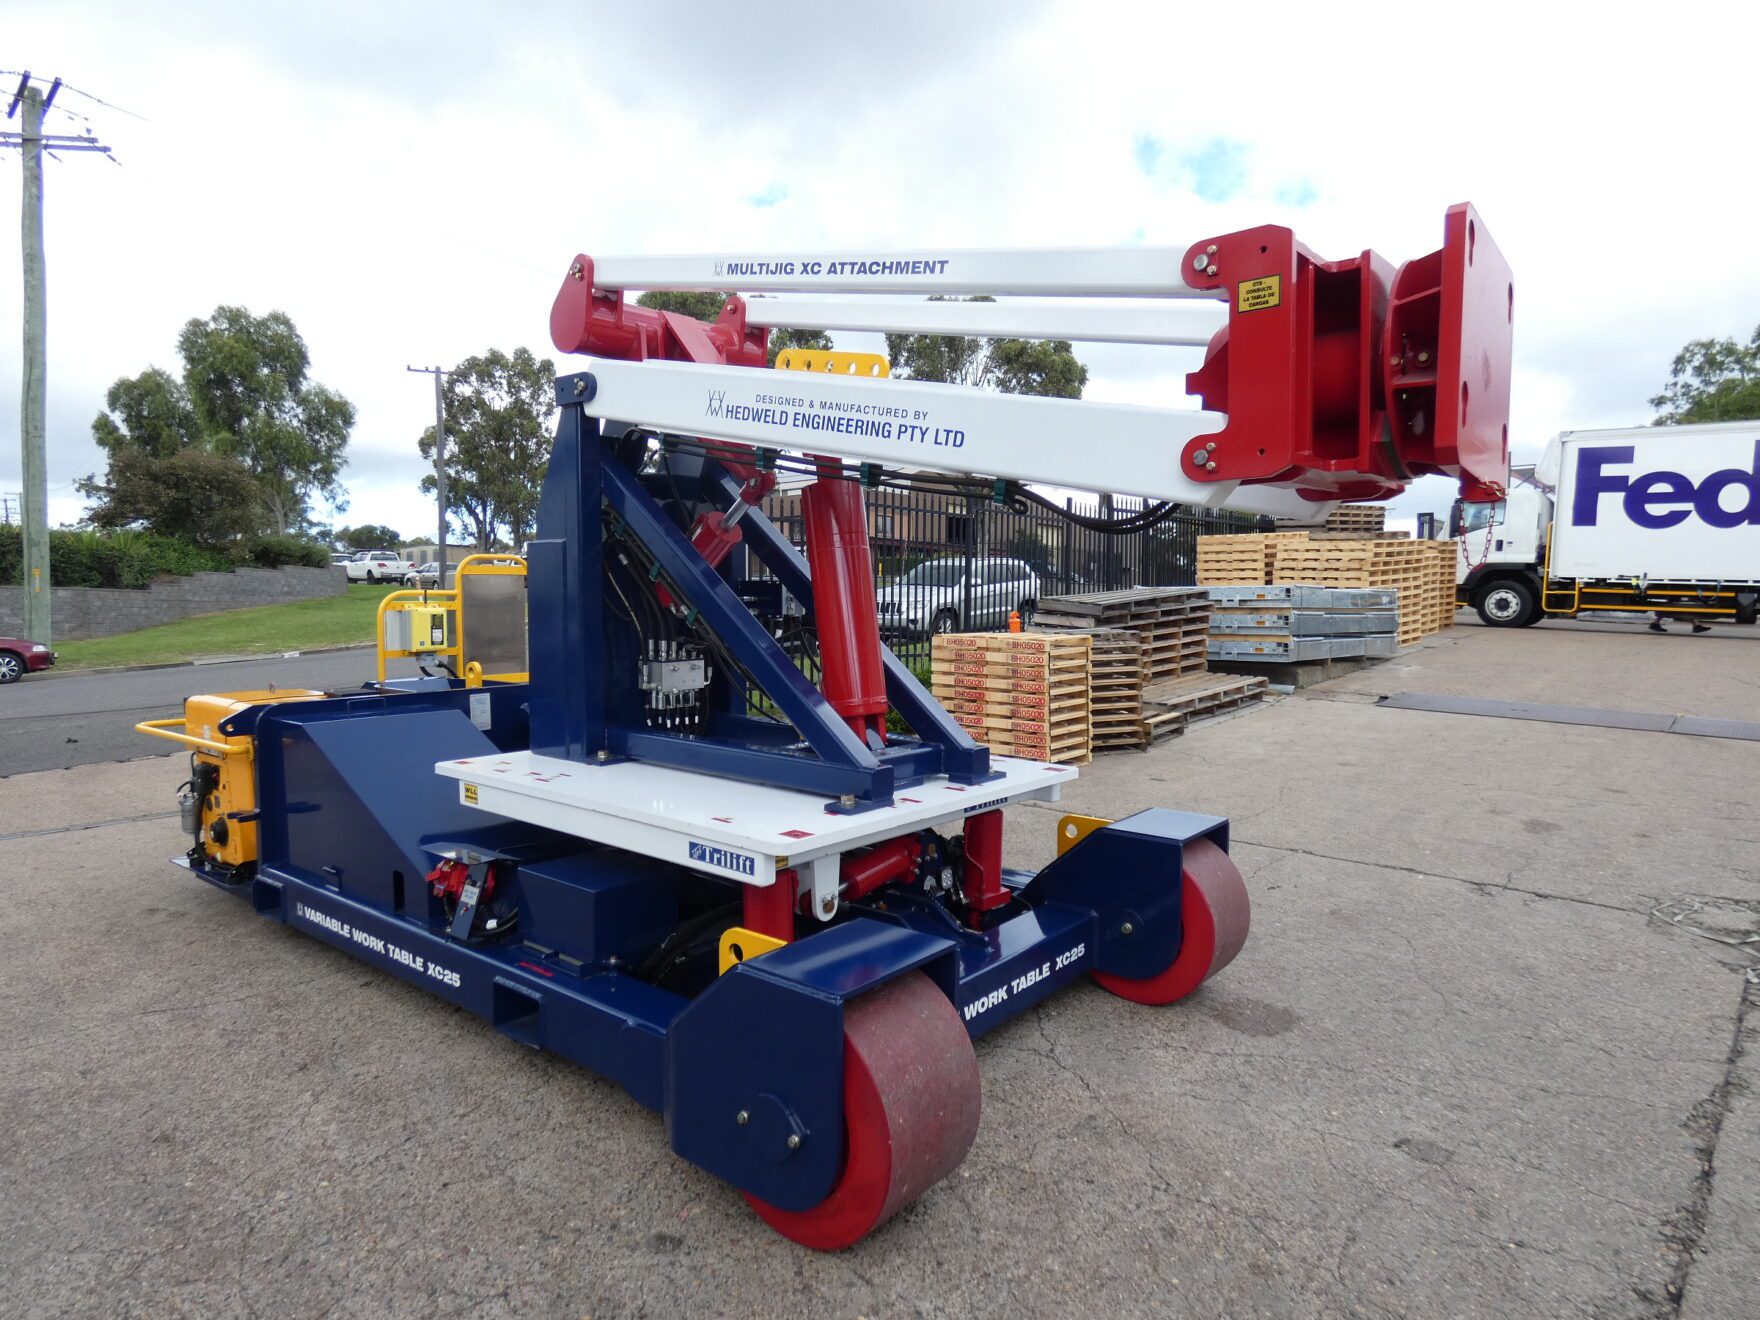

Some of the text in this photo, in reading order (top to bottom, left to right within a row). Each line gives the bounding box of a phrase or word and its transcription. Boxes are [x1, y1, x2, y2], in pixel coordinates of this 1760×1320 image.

[727, 260, 948, 276] MULTIJIG XC ATTACHMENT
[725, 404, 965, 449] HEDWELD ENGINEERING PTY LTD
[755, 394, 929, 421] DESIGNED & MANUFACTURED BY
[1572, 439, 1760, 530] Fed
[702, 845, 752, 874] Trilift
[304, 905, 461, 988] VARIABLE WORK TABLE XC25
[964, 943, 1085, 1021] WORK TABLE XC25
